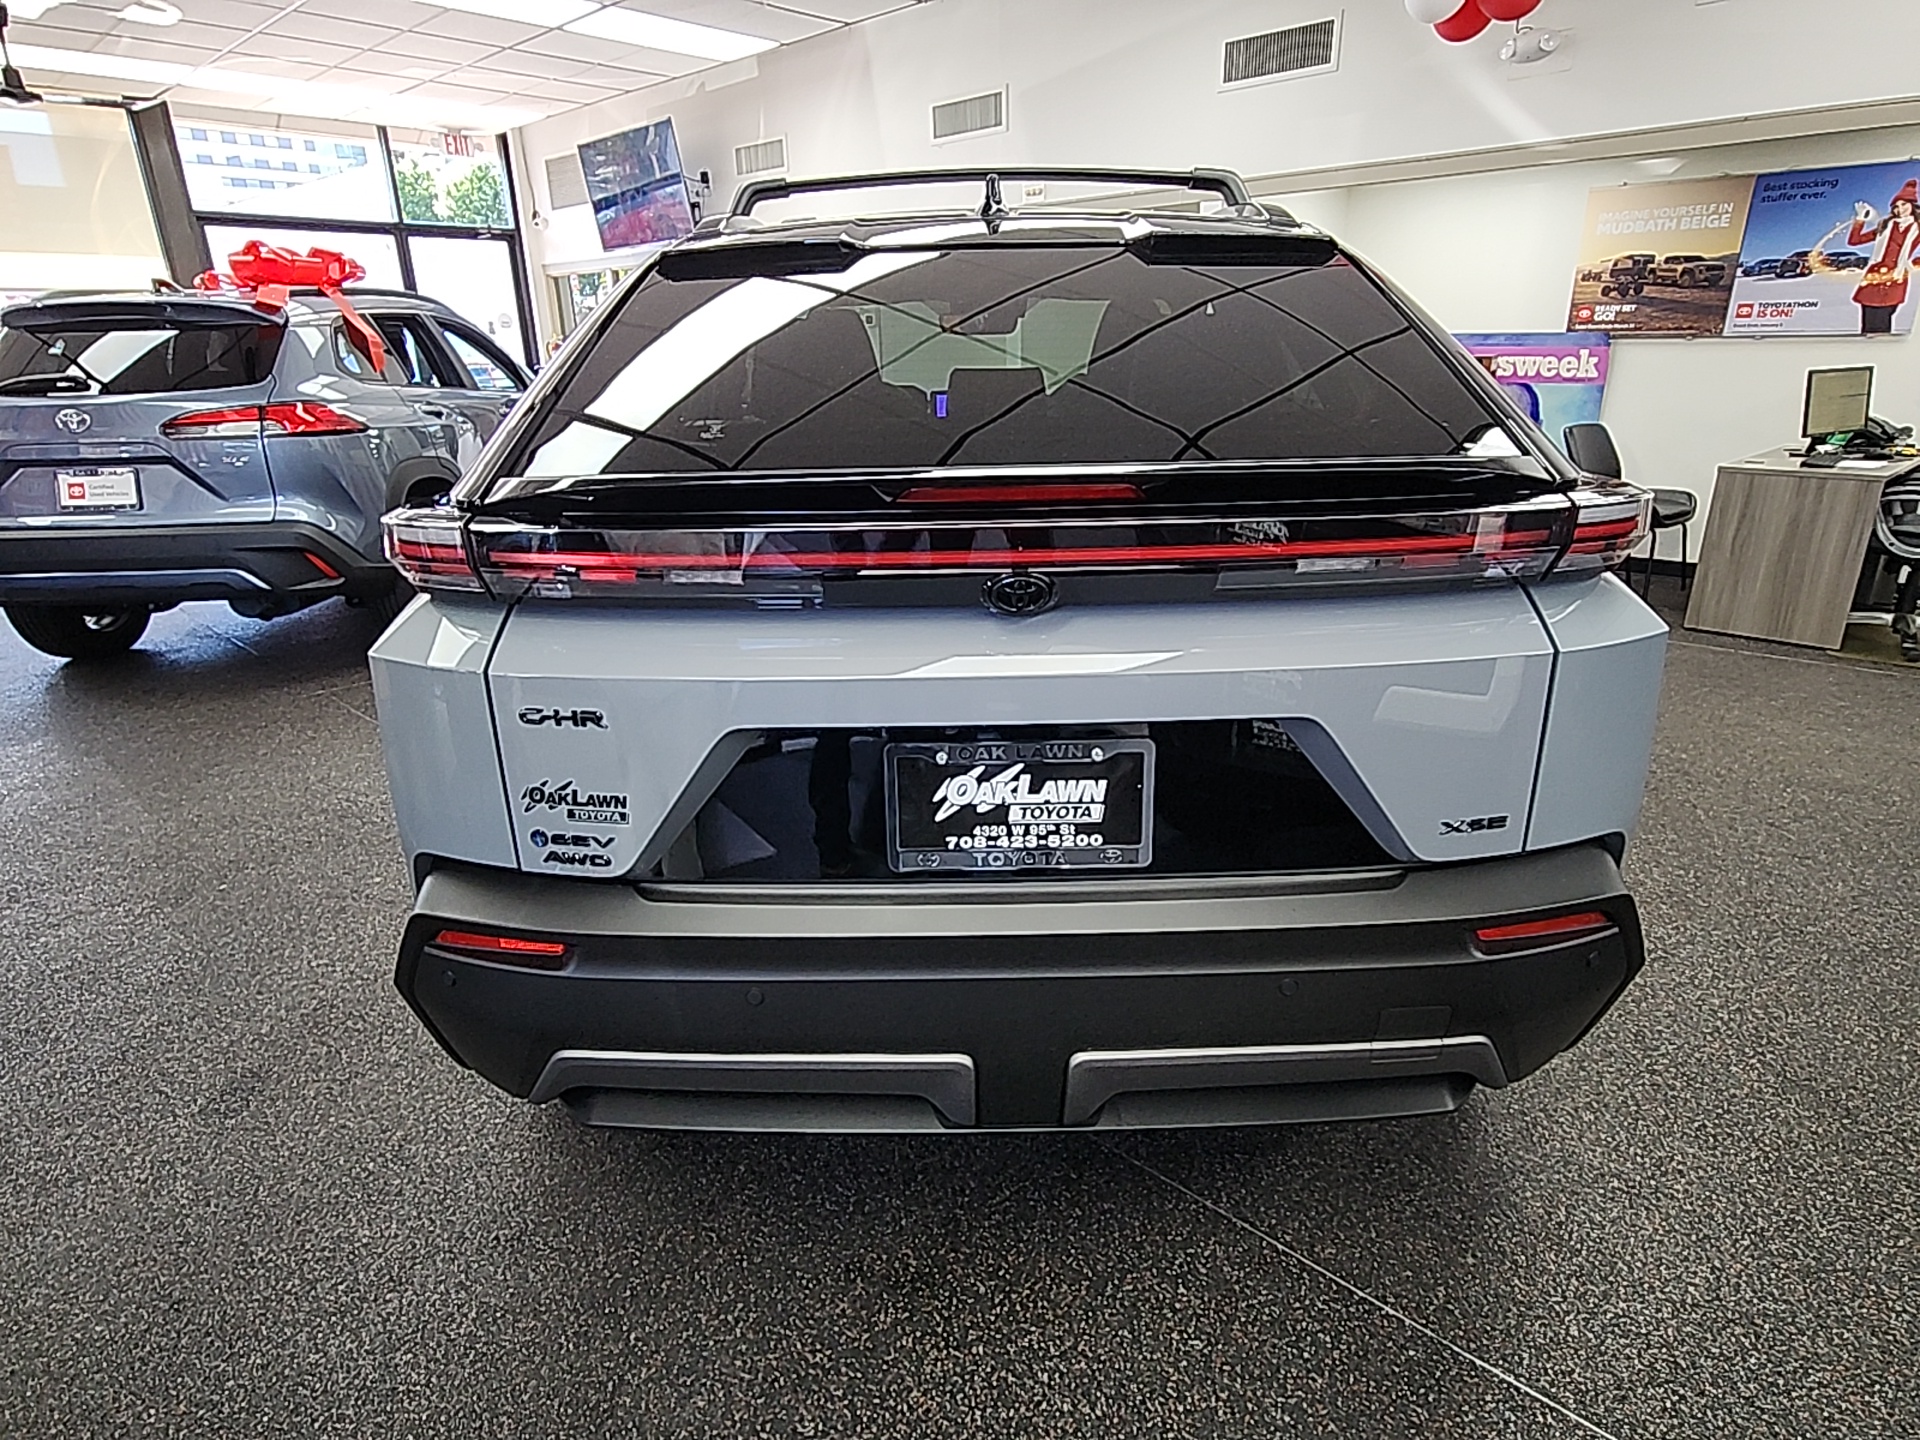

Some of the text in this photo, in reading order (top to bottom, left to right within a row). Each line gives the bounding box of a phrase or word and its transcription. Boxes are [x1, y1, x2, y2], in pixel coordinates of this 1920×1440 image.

[444, 133, 470, 157] EXIT
[1763, 178, 1839, 192] Best stocking
[1760, 191, 1827, 203] stuffer ever.
[1599, 202, 1734, 223] IMAGINE YOURSELF IN
[1596, 213, 1731, 235] MUDBATH BEIGE
[1621, 304, 1637, 312] SET
[1758, 301, 1818, 309] TOYOTATHON
[1594, 312, 1616, 321] GO!
[1757, 308, 1794, 318] IS ON!
[1493, 348, 1599, 378] sweek
[518, 707, 608, 729] C-HR
[956, 745, 1083, 759] OAK LAWN
[573, 809, 622, 821] TOYOTA
[1019, 805, 1093, 820] TOYOTA
[972, 823, 1075, 836] 4320 W 95th St
[1439, 815, 1509, 836] XSE
[945, 834, 1104, 849] 708-423-5200
[543, 850, 612, 867] AWD
[972, 850, 1068, 866] TOYOTA
